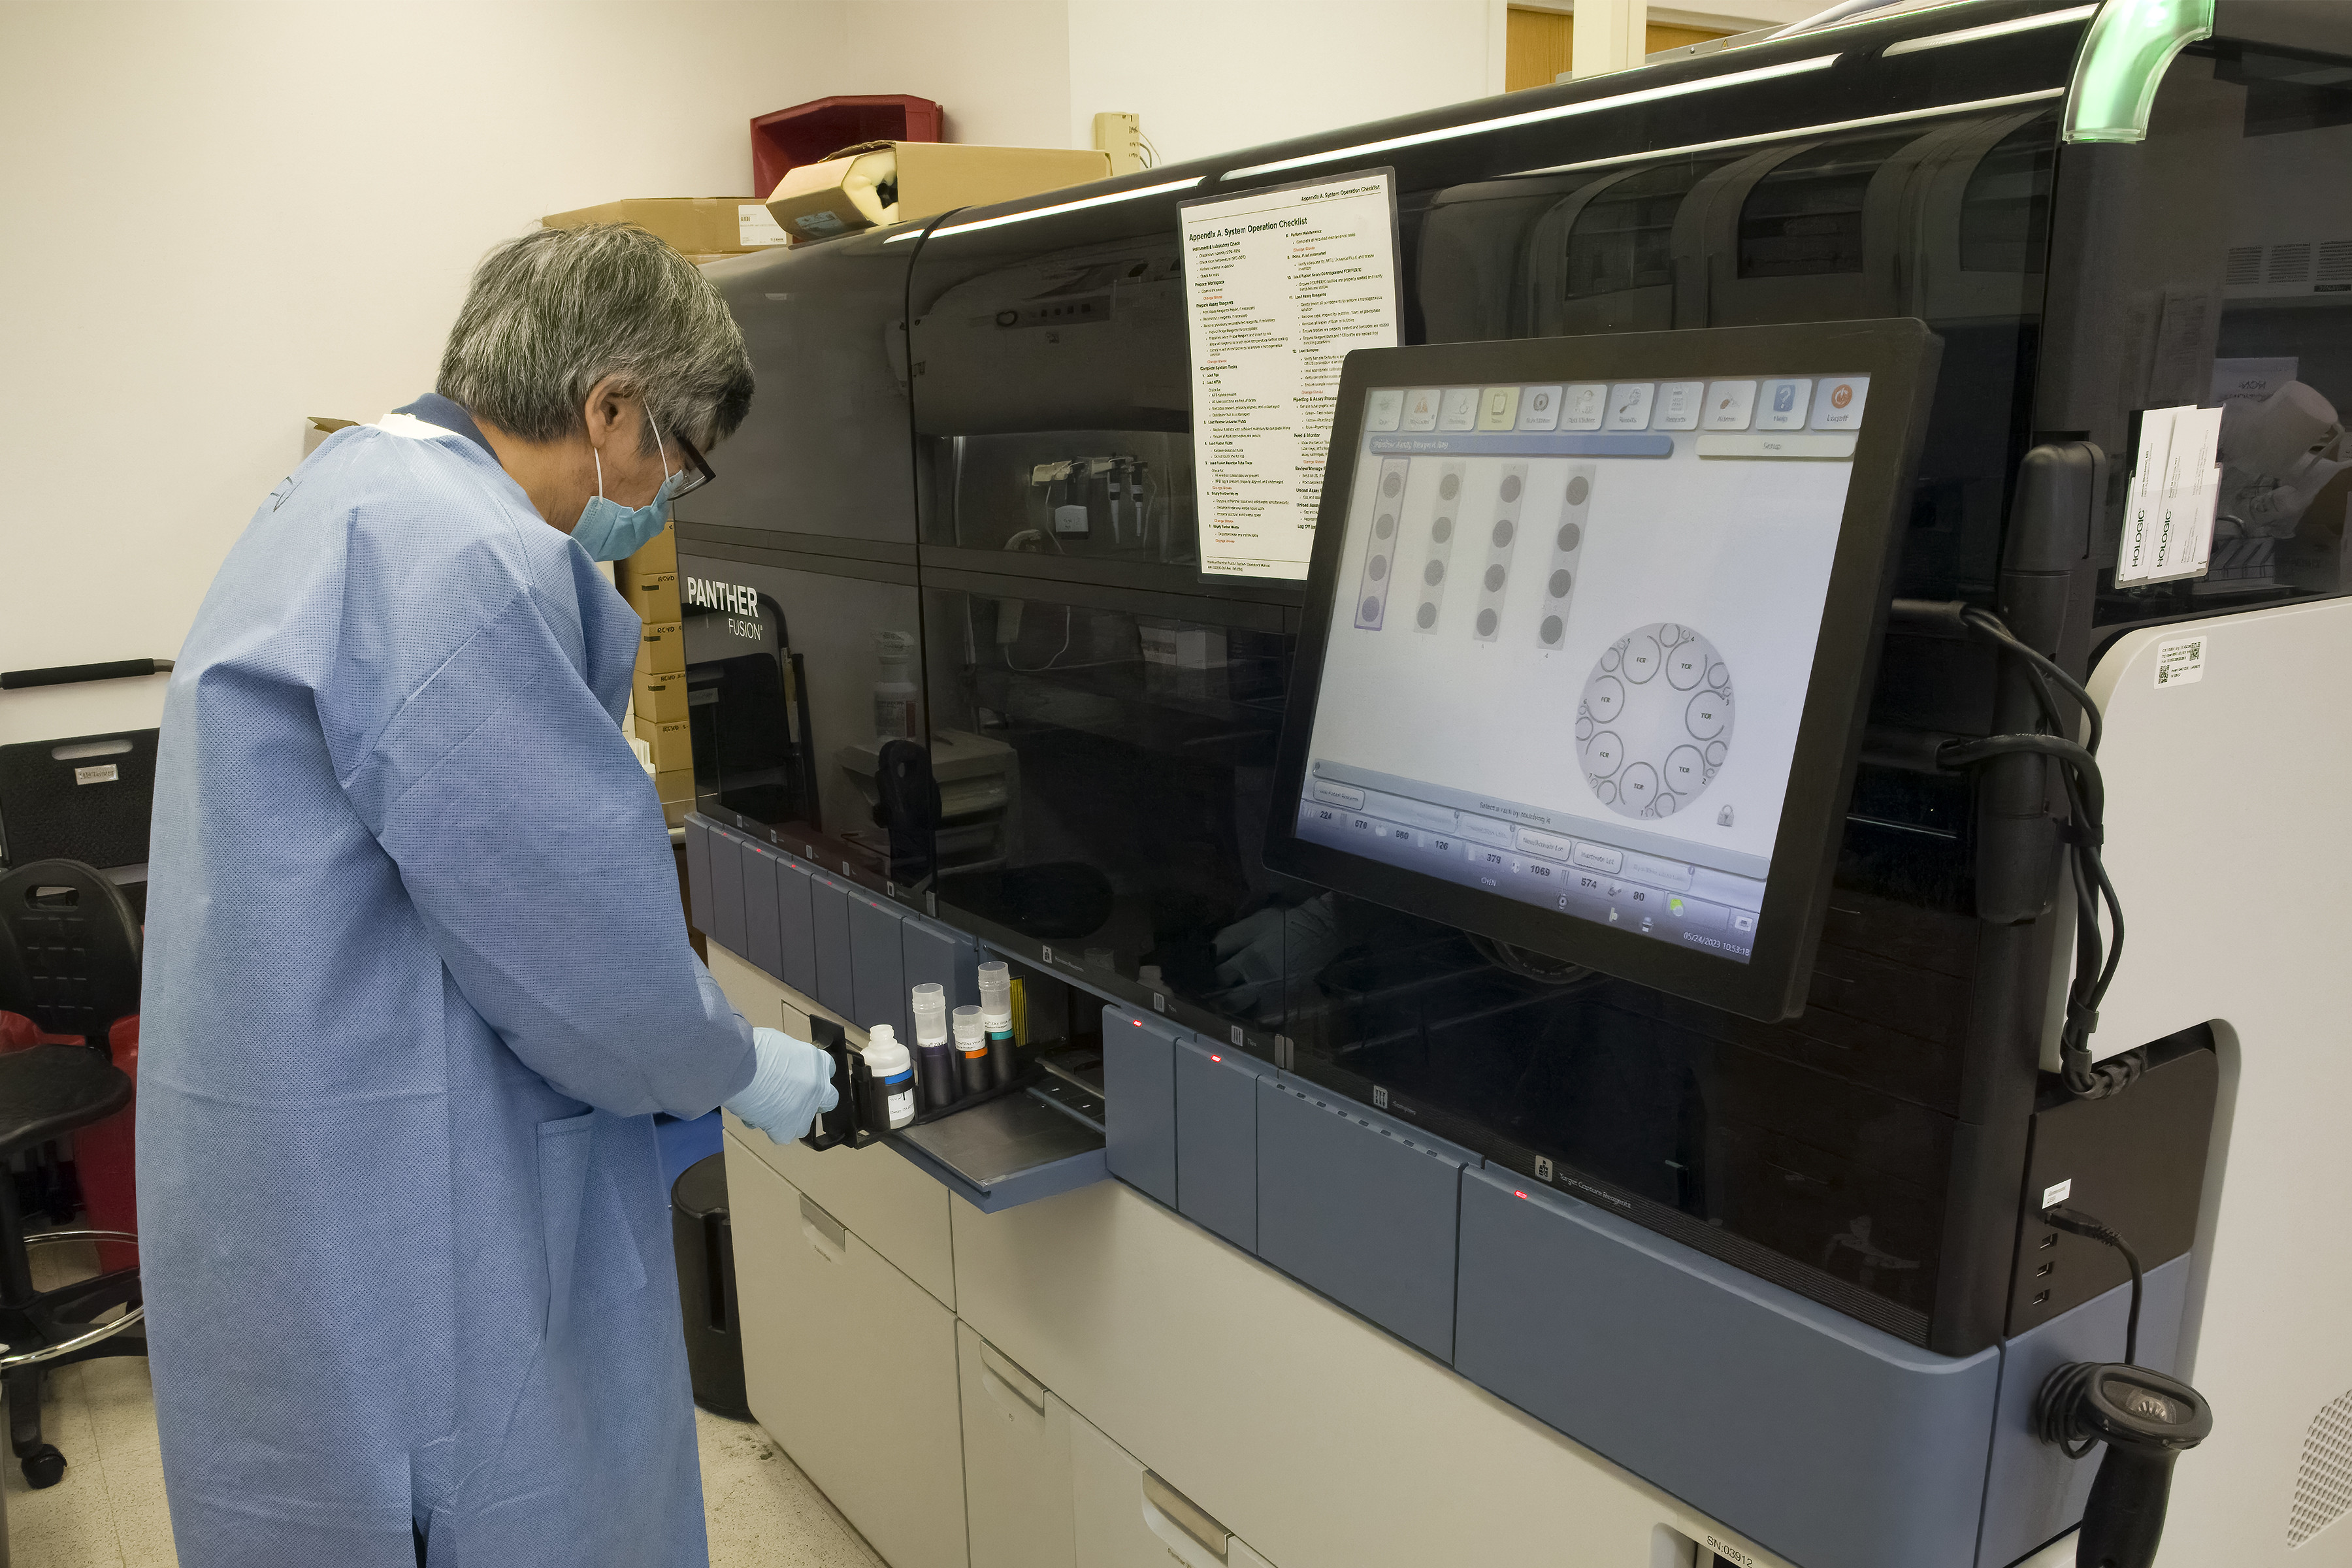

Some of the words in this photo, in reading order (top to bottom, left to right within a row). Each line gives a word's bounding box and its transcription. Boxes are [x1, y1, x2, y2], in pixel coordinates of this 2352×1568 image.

[1189, 231, 1216, 242] Appendix
[1225, 227, 1245, 237] System
[1248, 222, 1277, 233] Operation
[1279, 217, 1307, 227] Checklist
[2132, 509, 2145, 567] HOLOGIC
[2157, 510, 2172, 567] HOLOGIC
[687, 576, 759, 617] PANTHER
[728, 617, 762, 640] FUSION
[1320, 811, 1332, 819] 224
[1435, 841, 1448, 850] 126
[1487, 853, 1501, 864] 379
[1530, 865, 1550, 877] 1069
[1683, 932, 1720, 948] 05/24/2023
[1723, 943, 1750, 956] 10:53:18
[1560, 1173, 1578, 1186] Target
[1578, 1181, 1602, 1196] Capture
[1603, 1192, 1631, 1208] Reagents
[1707, 1535, 1753, 1568] SN:03912
